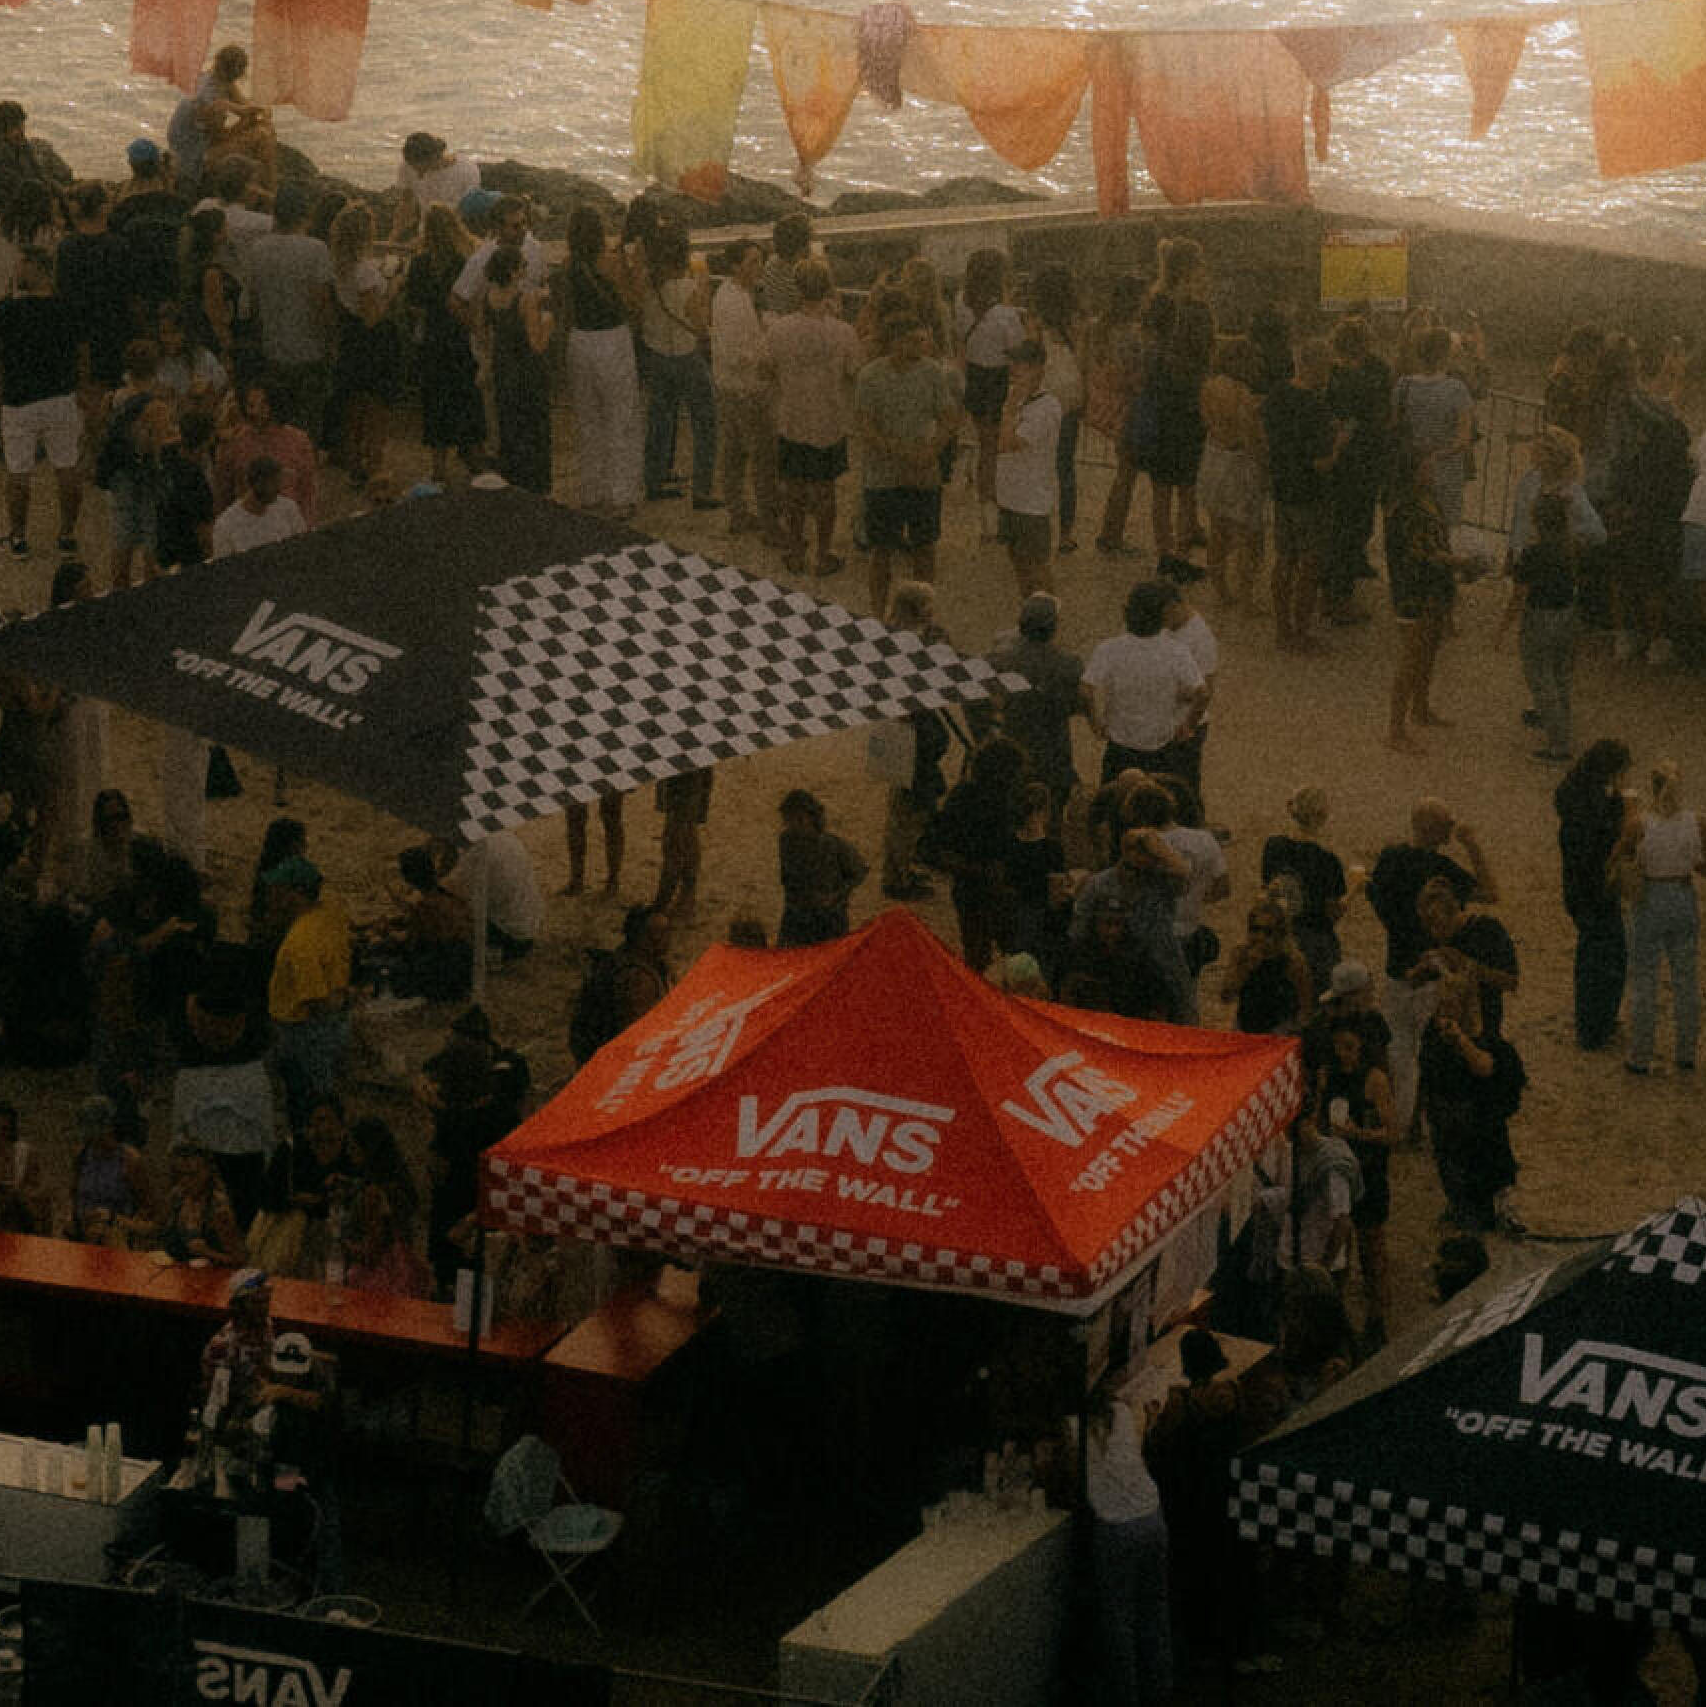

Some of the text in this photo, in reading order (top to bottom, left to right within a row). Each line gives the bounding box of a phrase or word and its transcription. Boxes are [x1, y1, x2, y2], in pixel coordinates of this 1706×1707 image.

[231, 599, 404, 694] VANS
[170, 647, 364, 730] "OFF THE WALL"
[736, 1085, 956, 1174] VANS
[659, 1163, 961, 1218] "OFF THE WALL"
[1444, 1406, 1534, 1441] "OFF
[1540, 1422, 1613, 1459] THE
